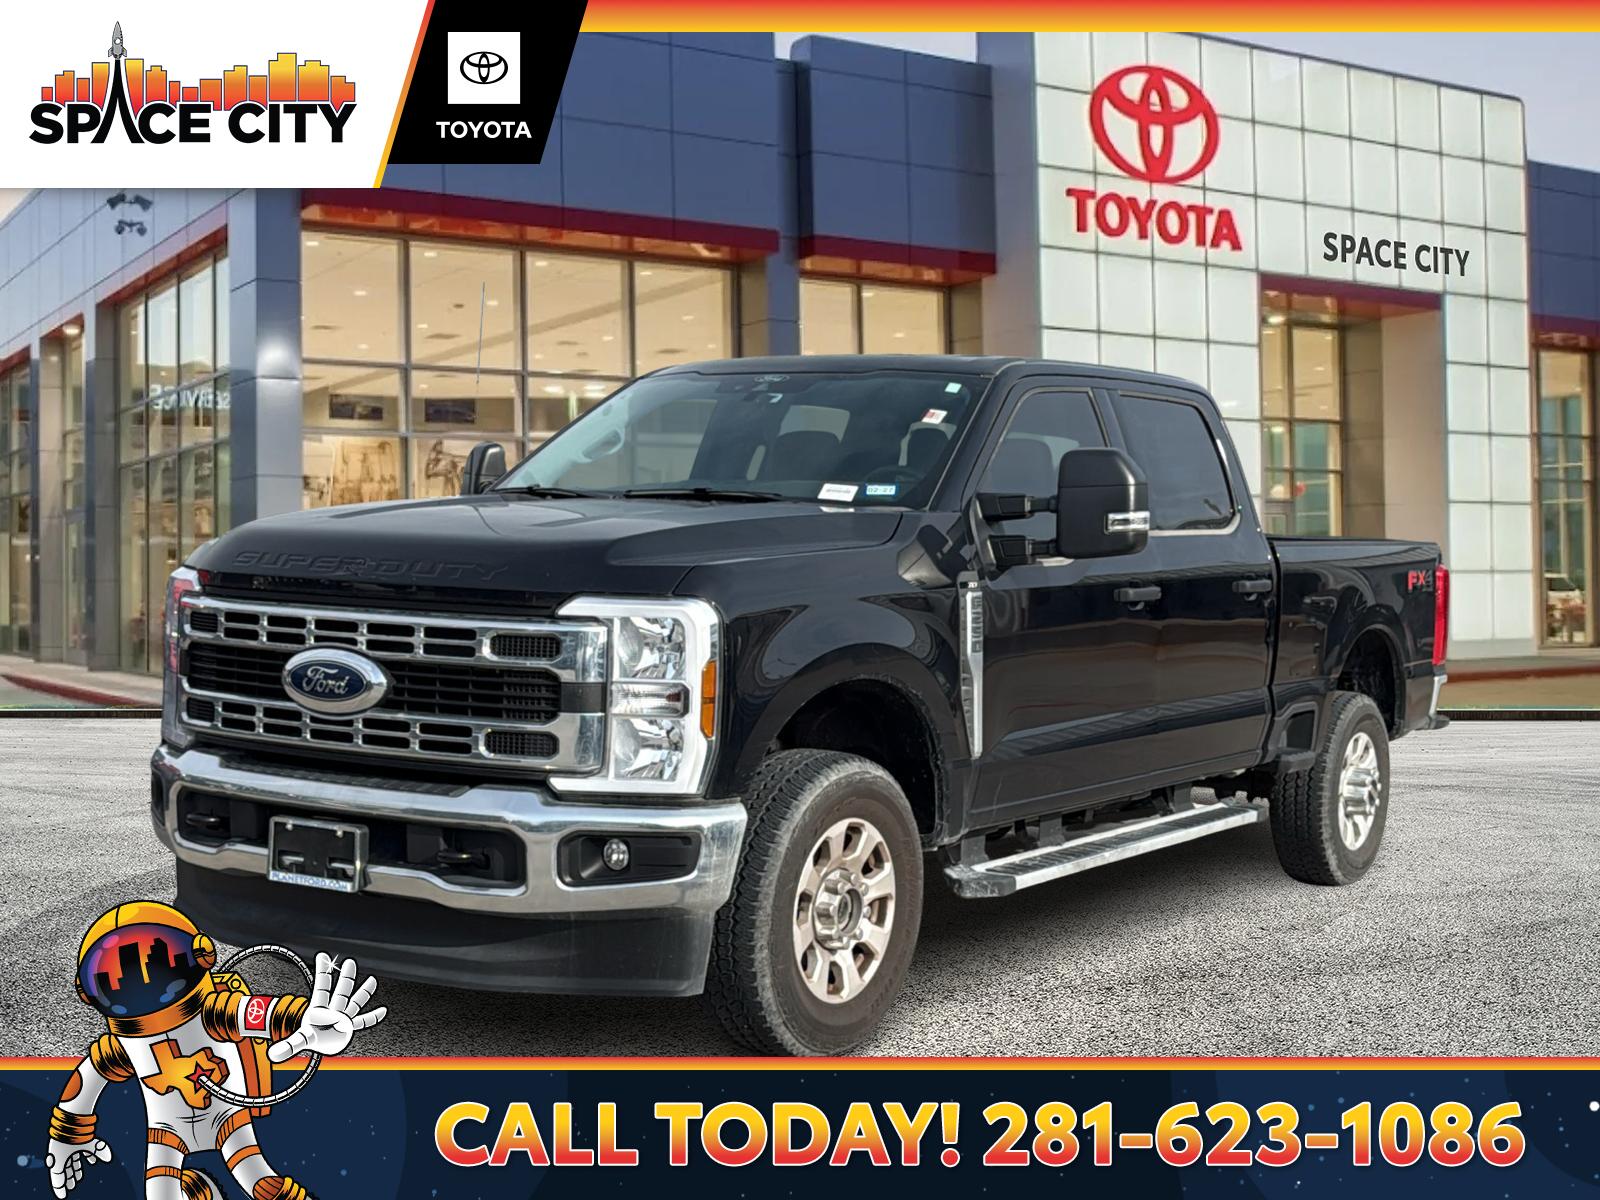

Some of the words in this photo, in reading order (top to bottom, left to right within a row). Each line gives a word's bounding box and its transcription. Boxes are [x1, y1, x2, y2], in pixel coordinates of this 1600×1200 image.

[1066, 188, 1242, 251] TOYOTA
[1323, 231, 1407, 270] SPACE
[1414, 244, 1470, 277] CITY
[232, 551, 369, 577] SUPER
[370, 559, 509, 581] DUTY
[302, 665, 350, 694] Ford
